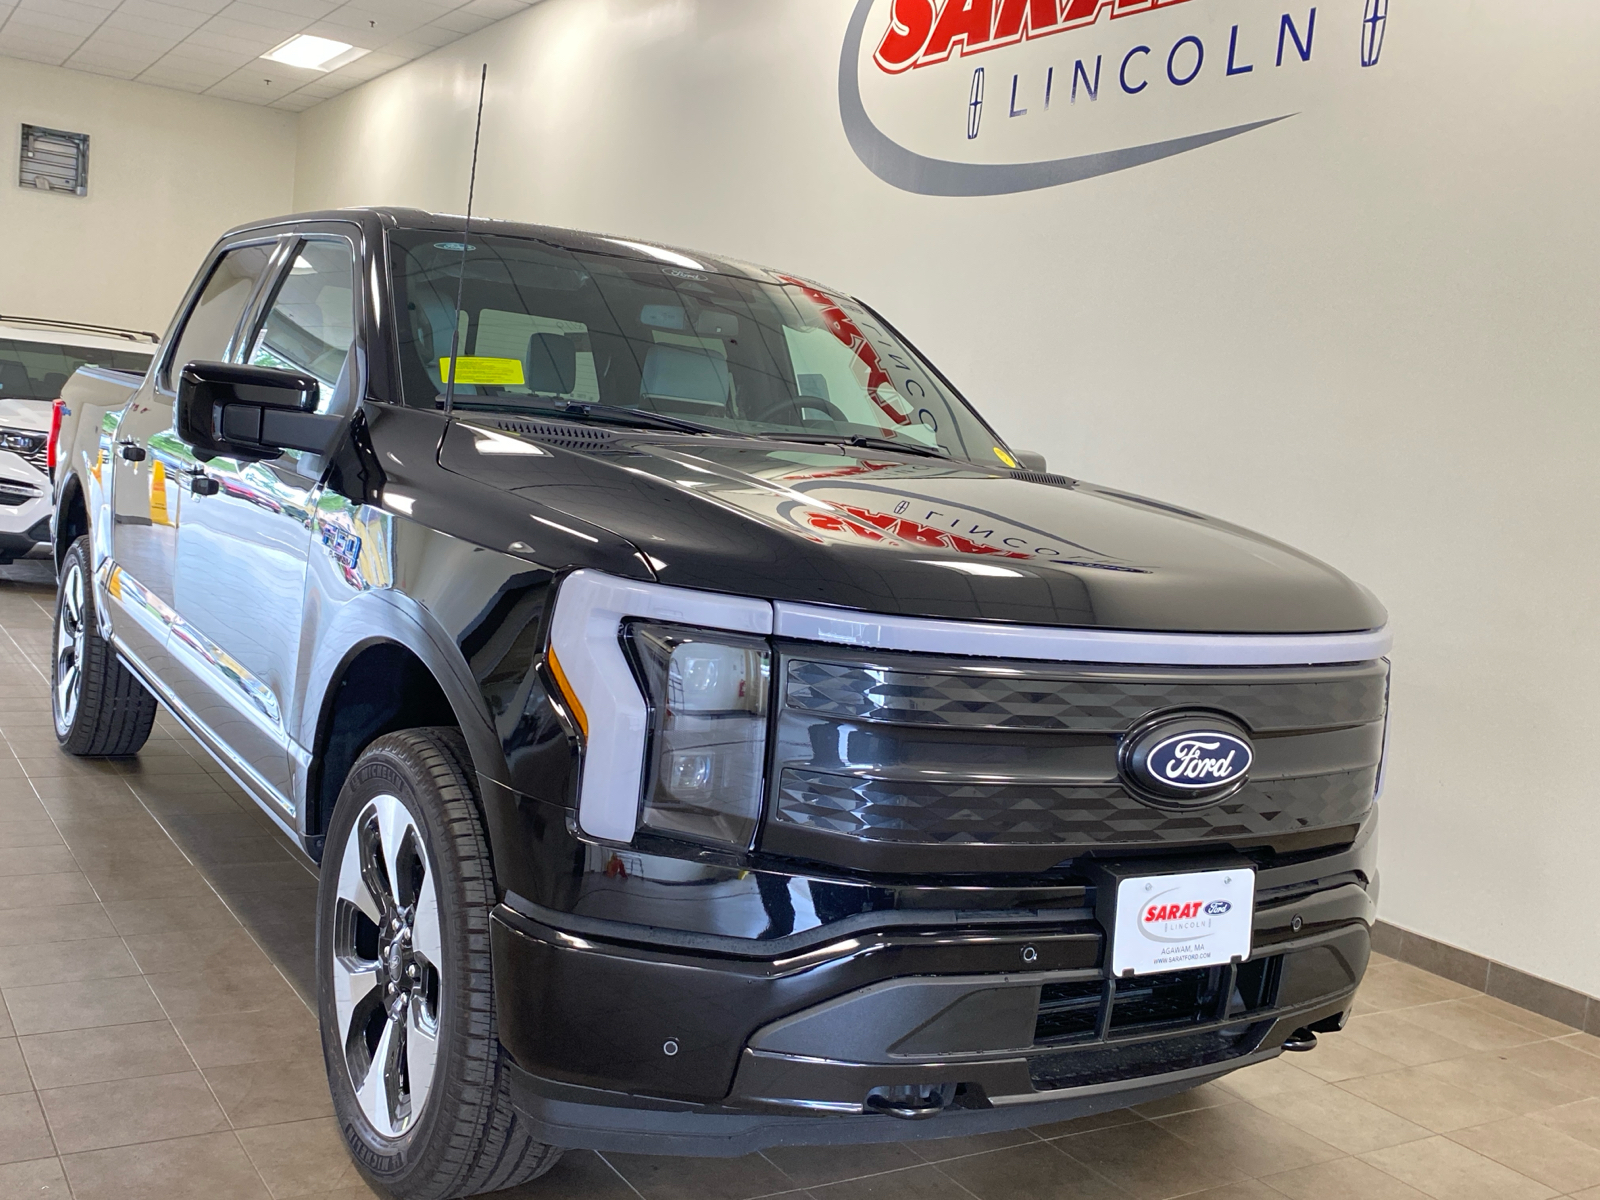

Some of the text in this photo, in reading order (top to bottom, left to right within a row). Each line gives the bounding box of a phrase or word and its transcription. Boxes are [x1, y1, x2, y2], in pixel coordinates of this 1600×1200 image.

[1009, 7, 1317, 118] LINCOLN
[1165, 740, 1236, 779] Ford
[361, 764, 403, 789] MICHELIN
[1144, 901, 1203, 923] SARAT
[1169, 920, 1206, 931] LINCOLN
[1161, 943, 1205, 955] AGAWAM, MA
